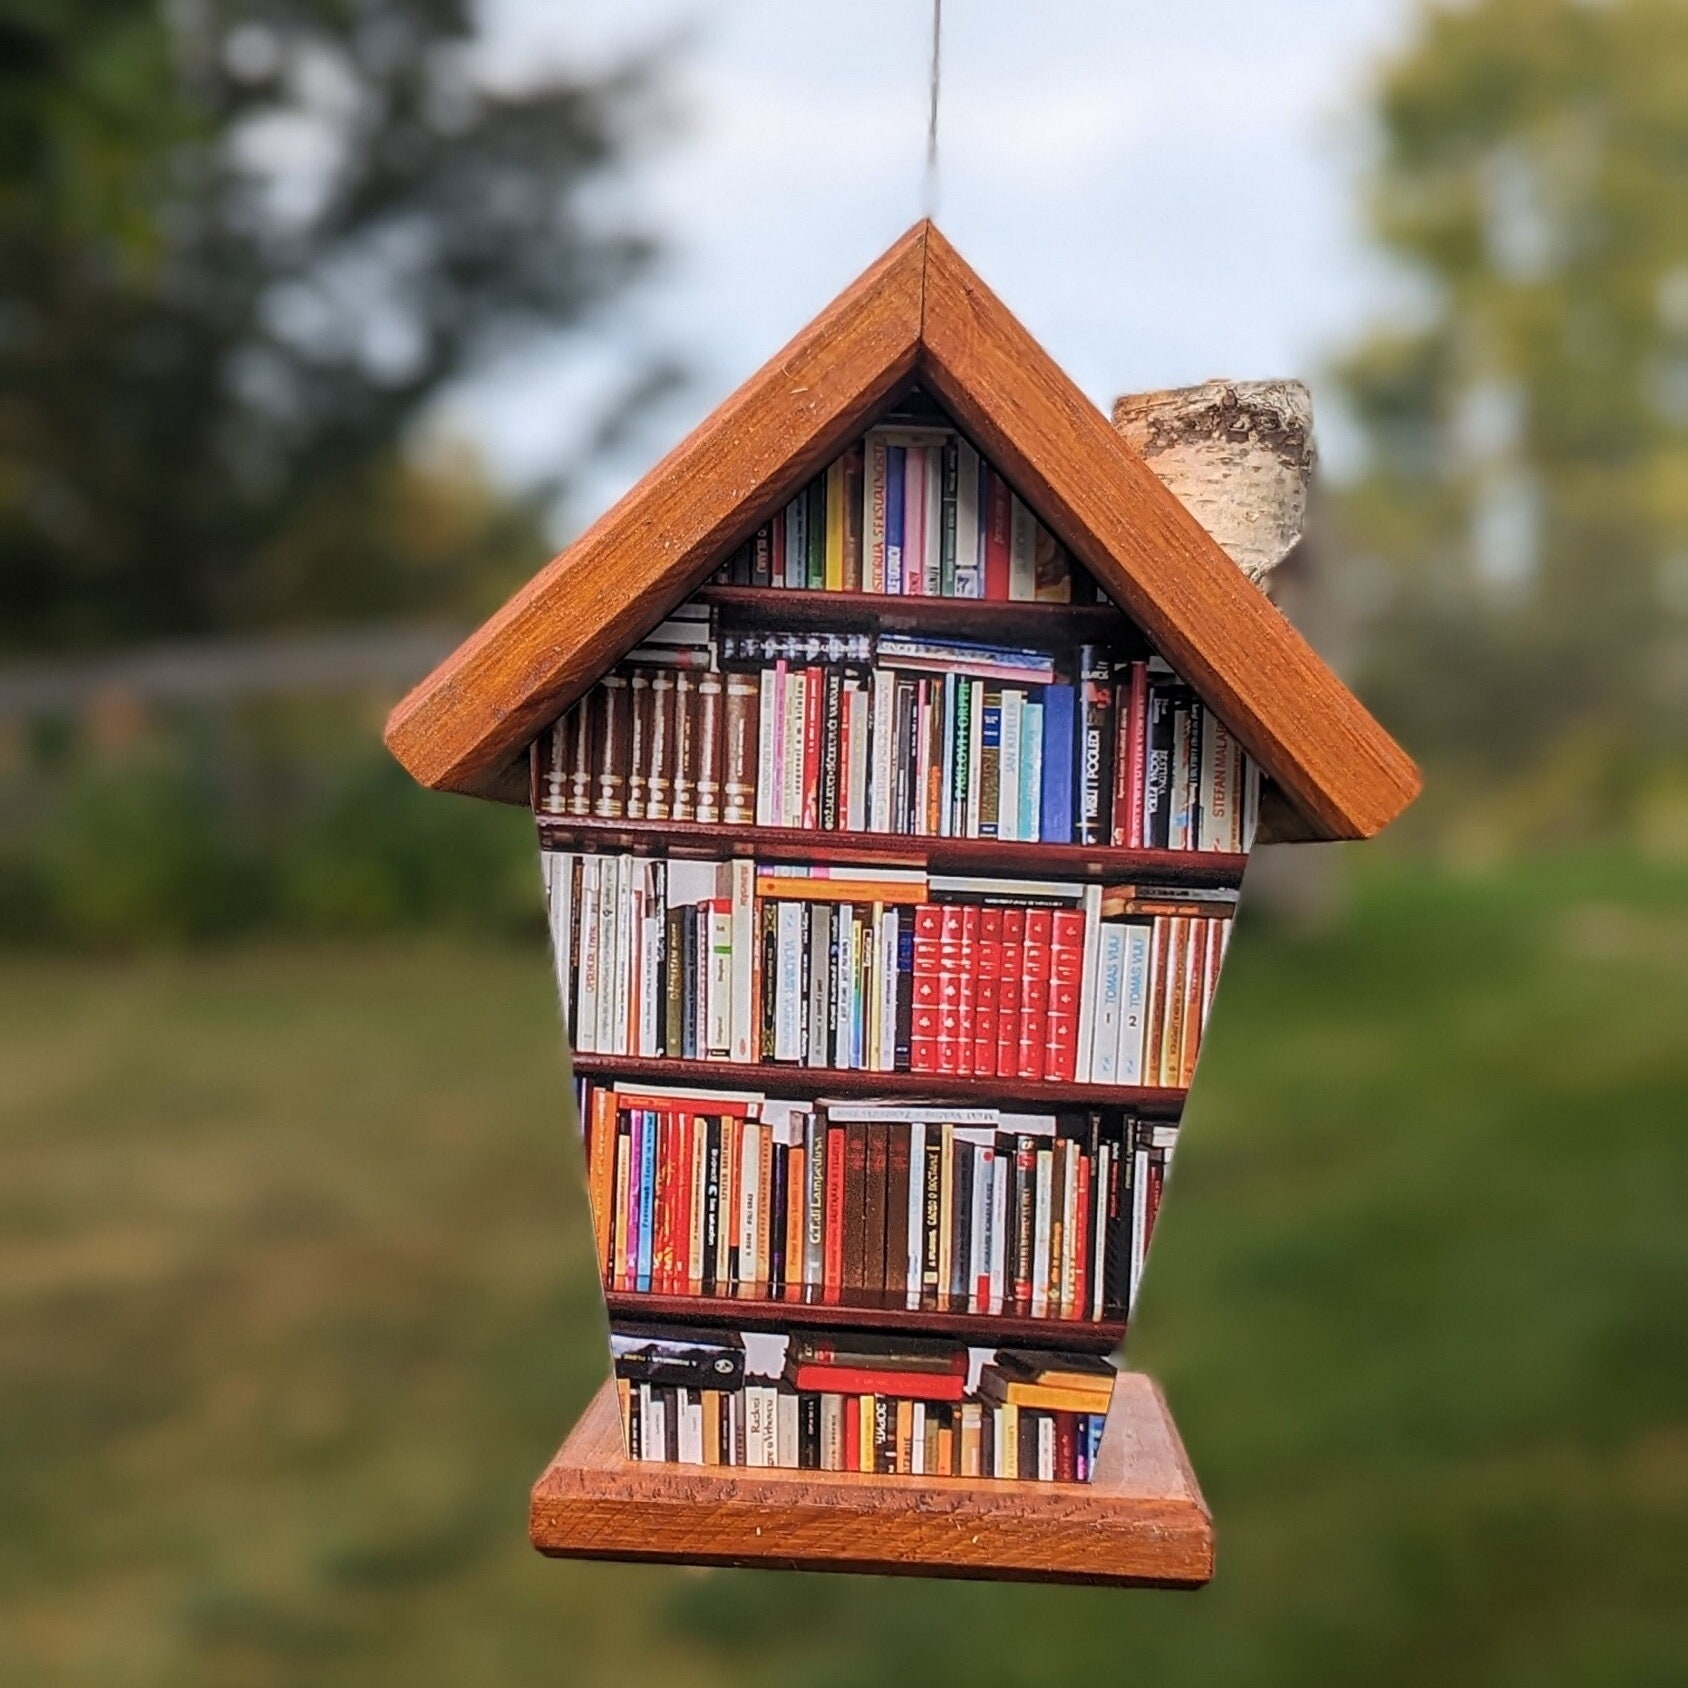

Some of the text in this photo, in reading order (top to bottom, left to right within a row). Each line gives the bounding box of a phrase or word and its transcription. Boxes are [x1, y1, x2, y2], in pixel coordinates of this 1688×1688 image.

[1087, 729, 1100, 778] POGLEDI
[1212, 769, 1226, 816] STEFAN
[1105, 963, 1117, 1004] TOMAS
[1129, 966, 1142, 1006] TOMAS
[1129, 1014, 1137, 1027] 2
[809, 1135, 823, 1206] Lampedusa
